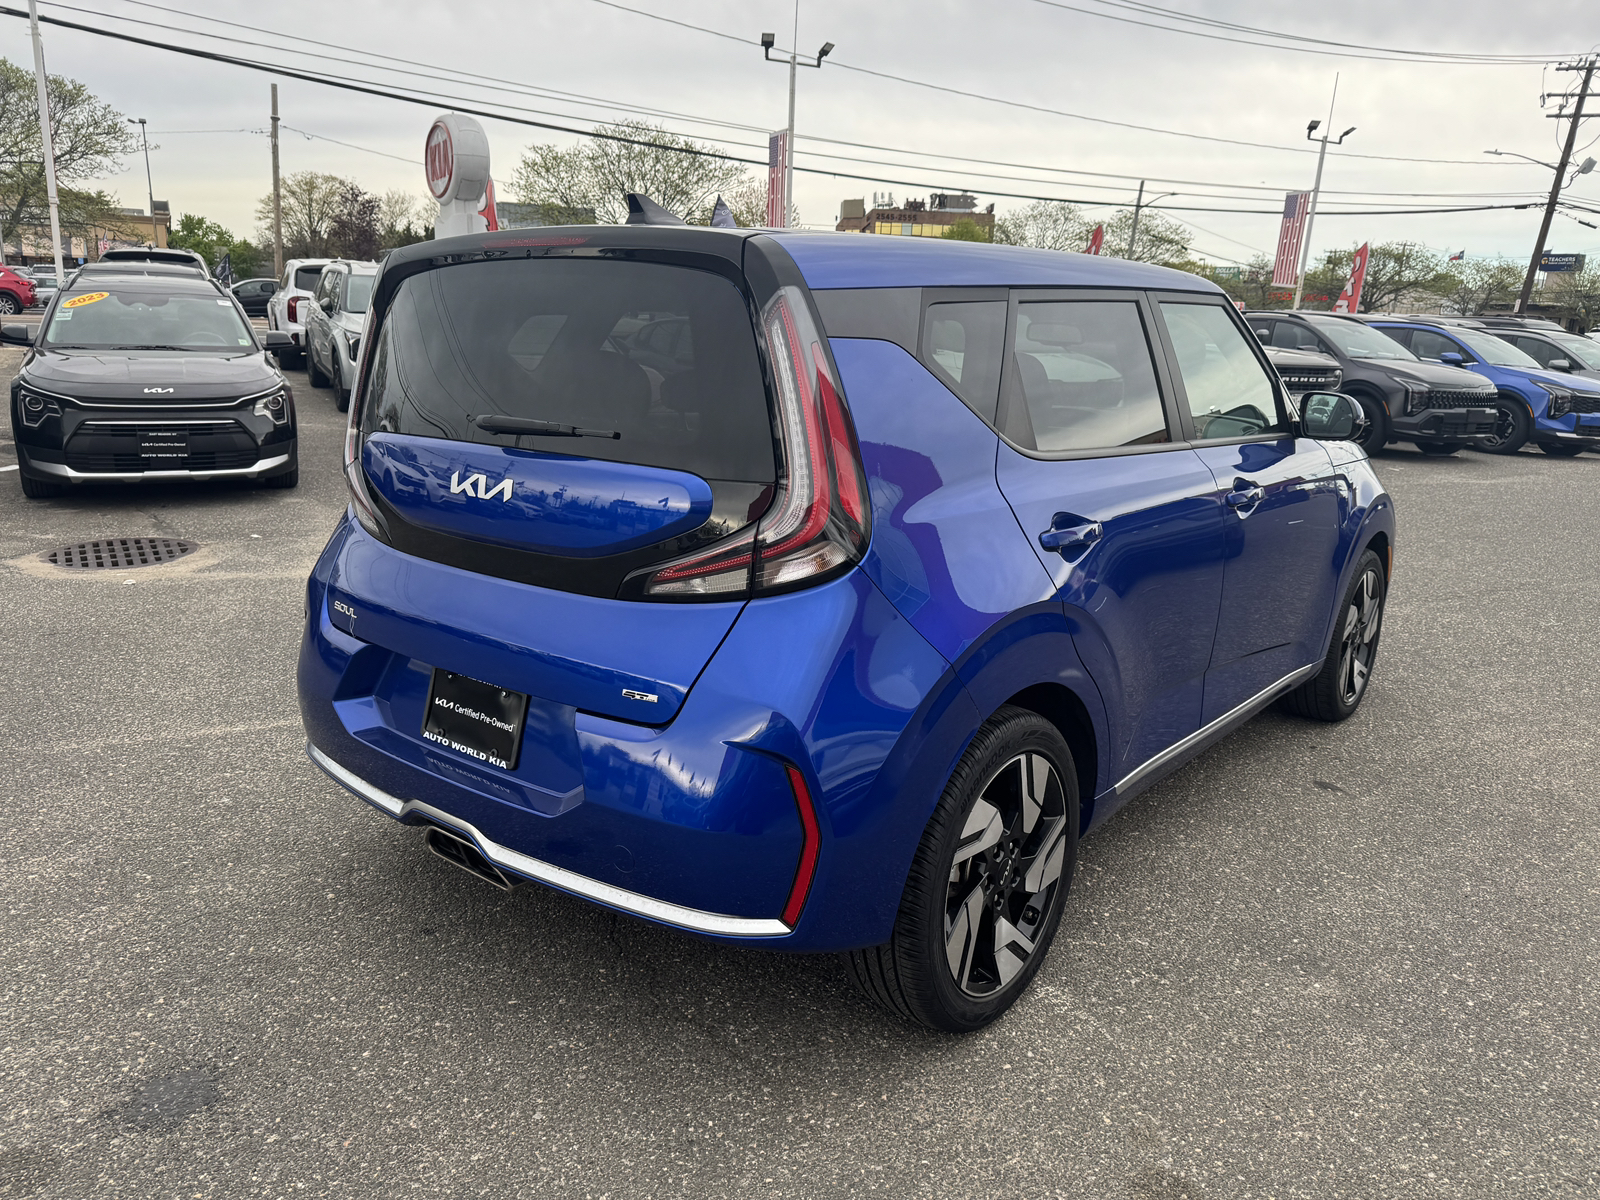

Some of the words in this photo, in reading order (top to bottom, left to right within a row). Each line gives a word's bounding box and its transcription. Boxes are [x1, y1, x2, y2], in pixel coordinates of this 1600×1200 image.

[429, 139, 451, 182] KIA
[68, 293, 105, 306] 2023
[450, 470, 514, 503] KIA
[334, 600, 358, 619] SOUL
[435, 697, 455, 710] KIA
[454, 703, 481, 720] Certified
[422, 730, 449, 746] AUTO
[451, 741, 487, 761] WORLD
[488, 756, 508, 770] KIA
